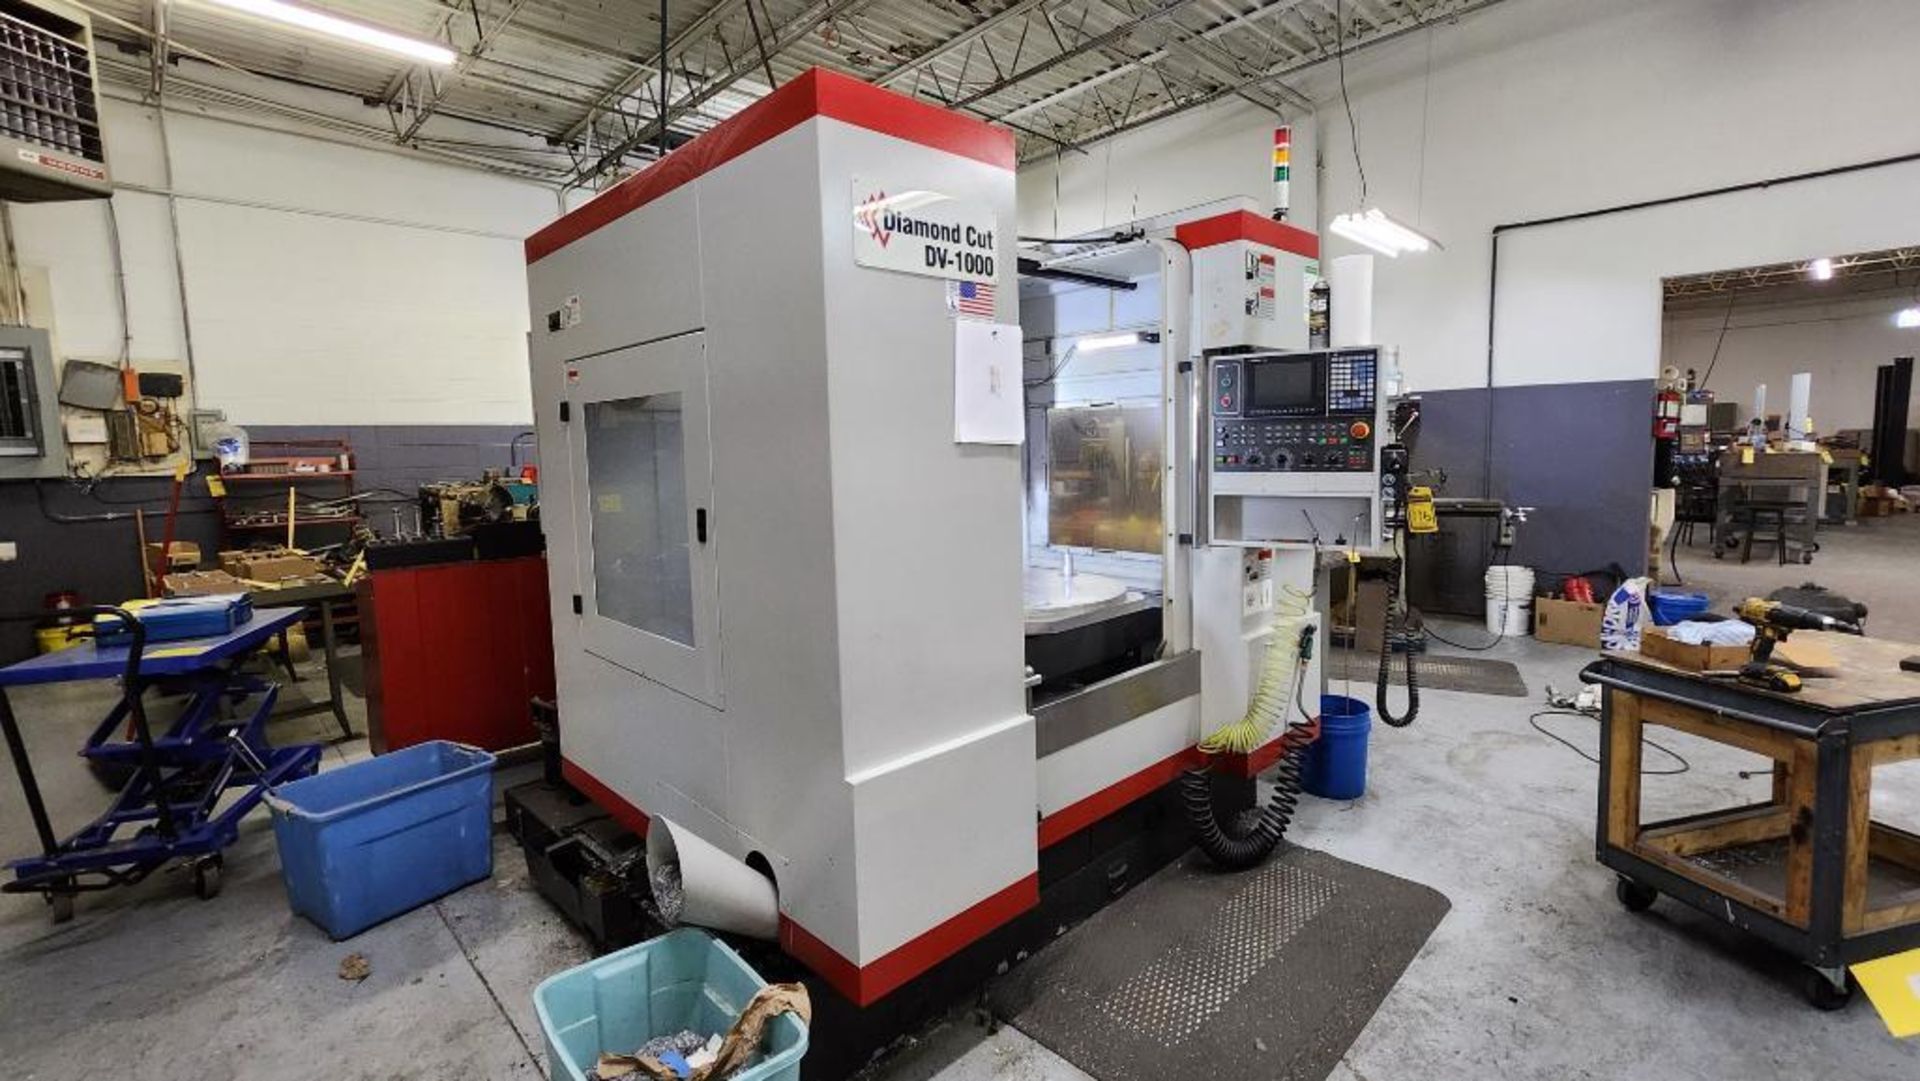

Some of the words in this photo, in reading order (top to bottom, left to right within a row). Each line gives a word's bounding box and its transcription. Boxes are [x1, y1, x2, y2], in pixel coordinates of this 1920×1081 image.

[883, 209, 961, 244] Diamond
[966, 225, 993, 250] Cut
[925, 245, 994, 277] DV-1000
